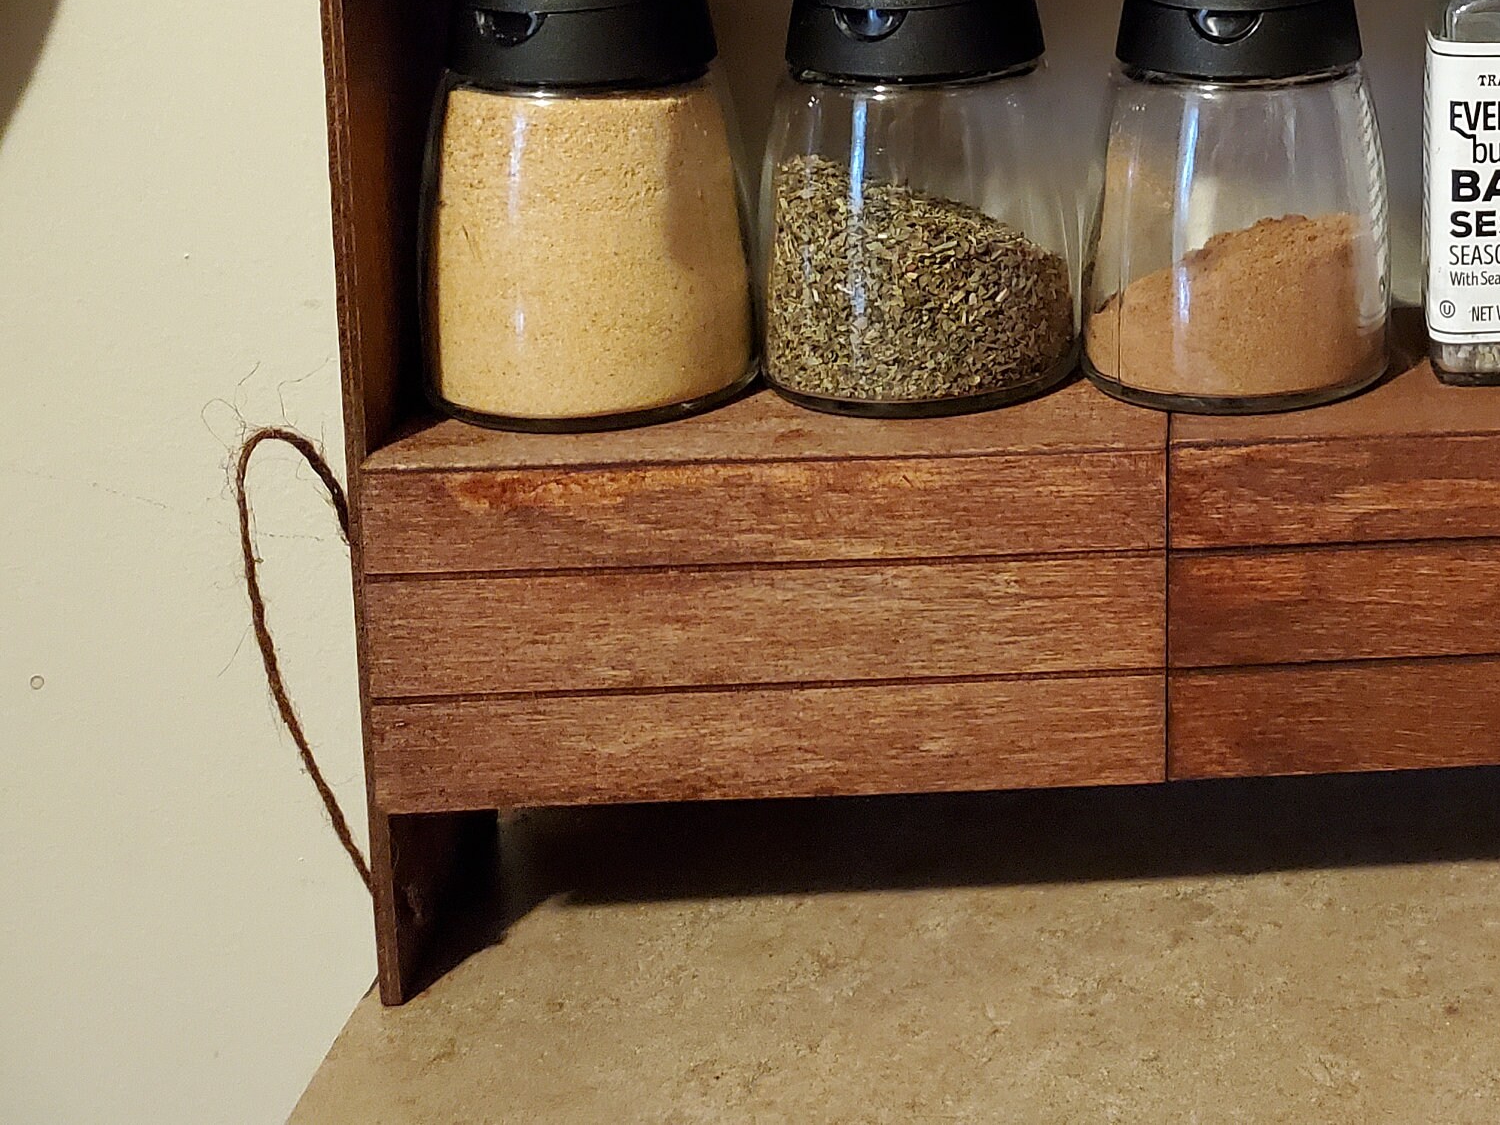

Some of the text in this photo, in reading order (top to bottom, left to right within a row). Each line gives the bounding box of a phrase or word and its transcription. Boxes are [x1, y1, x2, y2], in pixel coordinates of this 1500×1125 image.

[1450, 270, 1479, 286] With
[1480, 271, 1500, 285] Sea
[1472, 306, 1494, 322] NET
